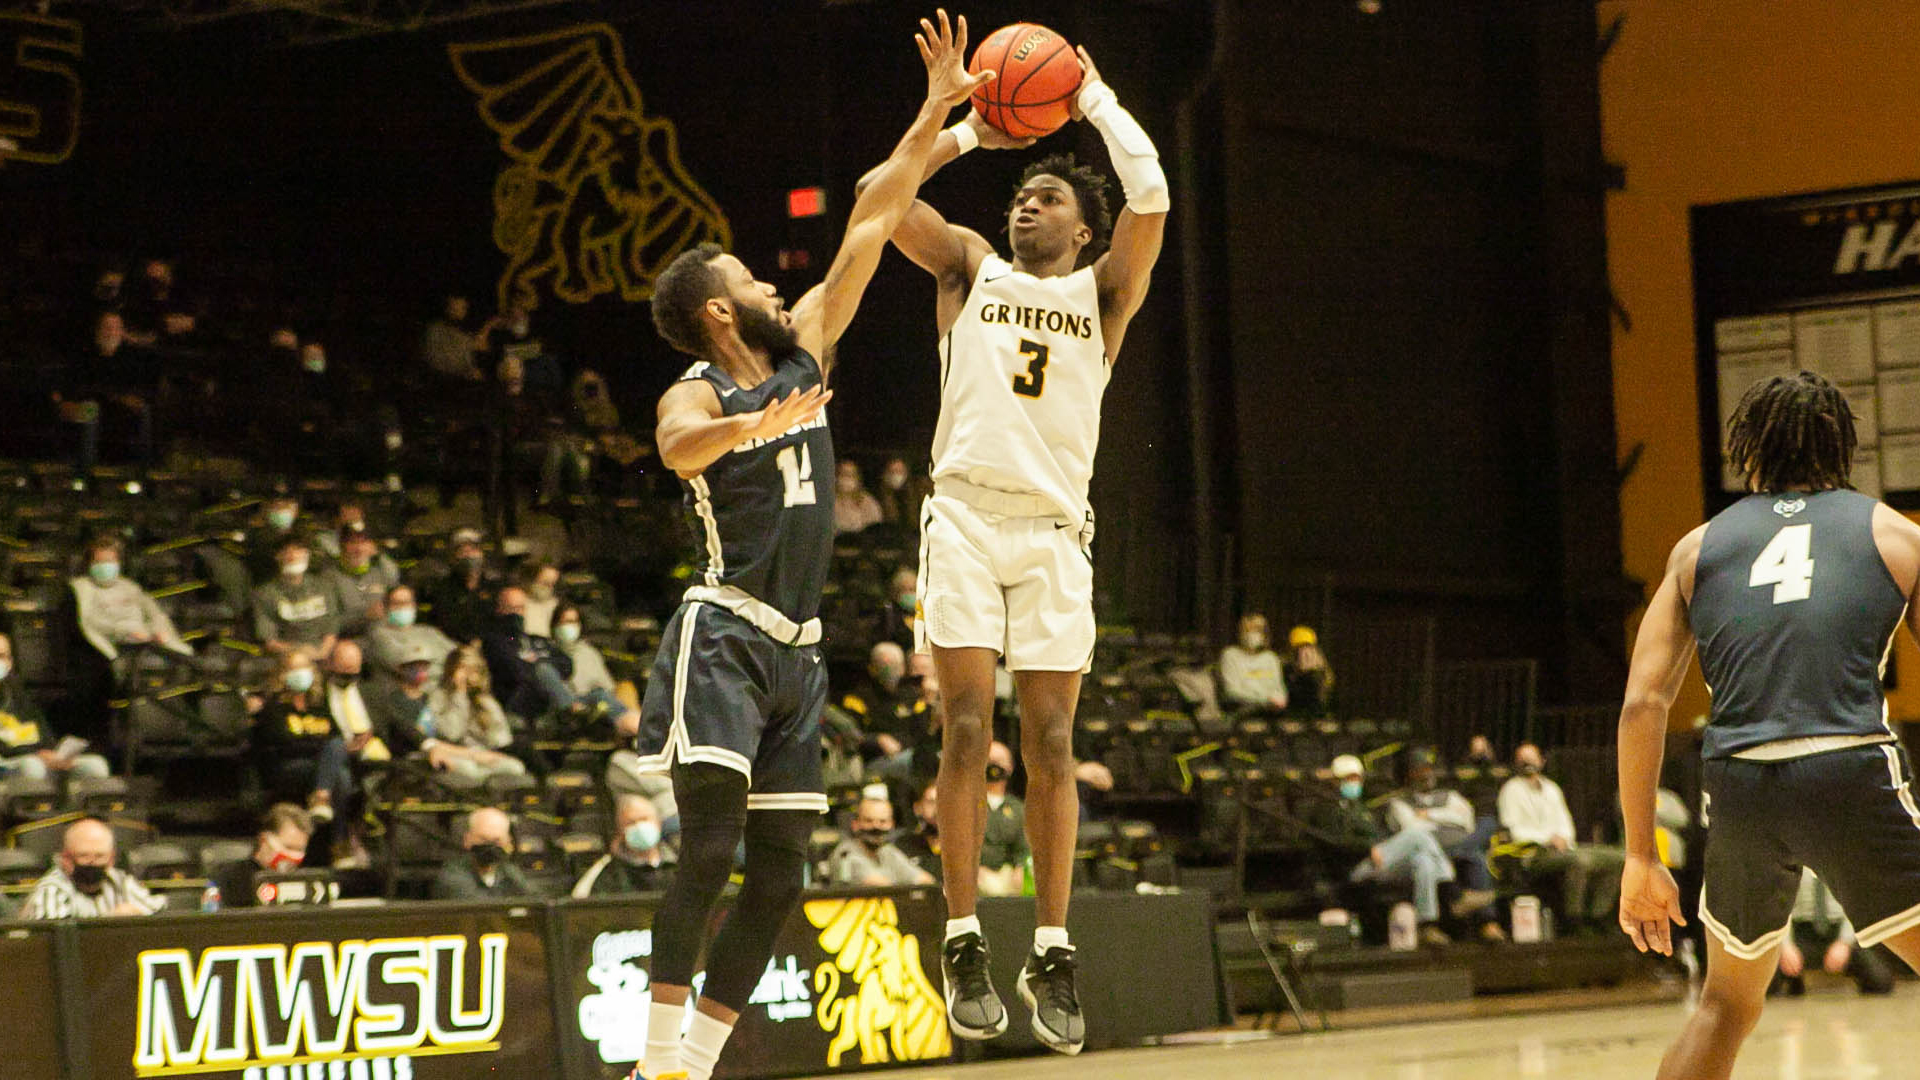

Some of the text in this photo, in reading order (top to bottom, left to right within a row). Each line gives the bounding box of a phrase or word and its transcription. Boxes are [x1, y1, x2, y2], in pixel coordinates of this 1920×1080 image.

[980, 303, 1092, 339] GRIFFONS
[1012, 338, 1049, 399] 3
[1749, 524, 1814, 605] 4
[134, 934, 508, 1067] MWSU
